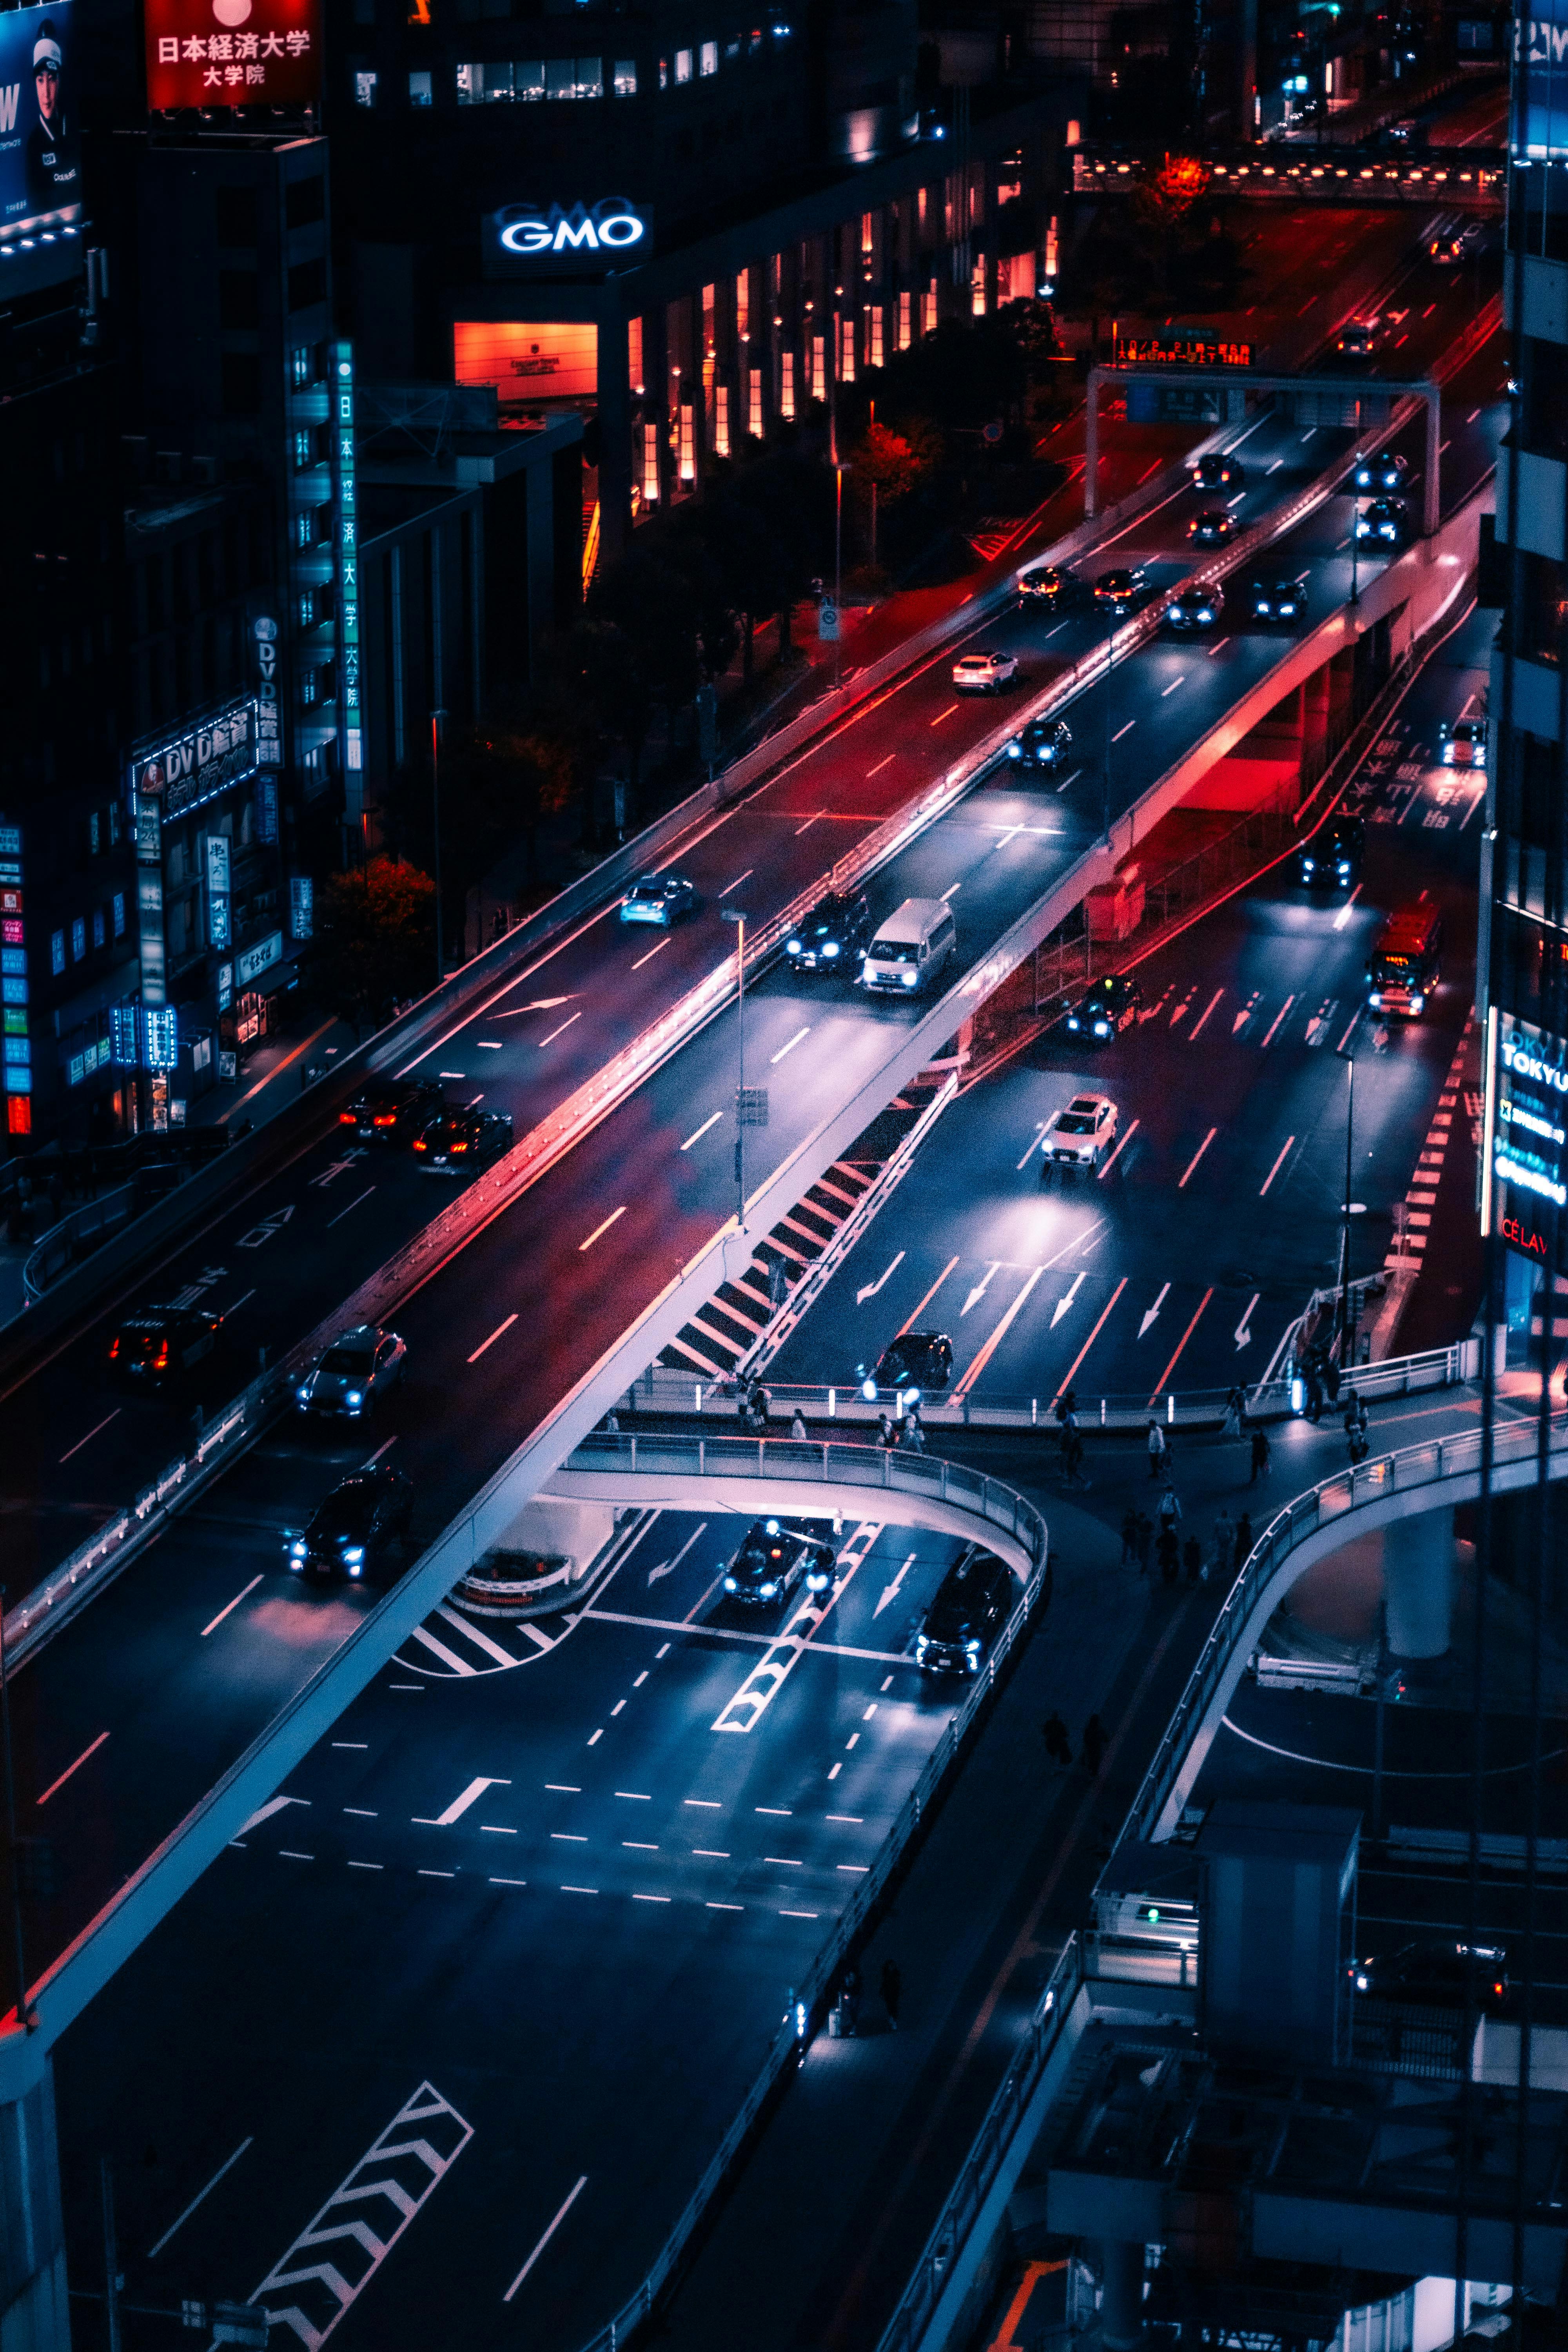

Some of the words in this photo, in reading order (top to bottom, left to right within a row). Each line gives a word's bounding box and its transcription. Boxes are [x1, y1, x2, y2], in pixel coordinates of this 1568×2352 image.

[158, 30, 310, 64] 日本経済大学
[203, 64, 265, 87] 大学院
[501, 216, 643, 251] GMO
[259, 642, 278, 738] DVD鑑賞
[166, 712, 248, 784] DVD鑑賞
[141, 831, 155, 842] 24
[1502, 1042, 1568, 1091] TOKYU
